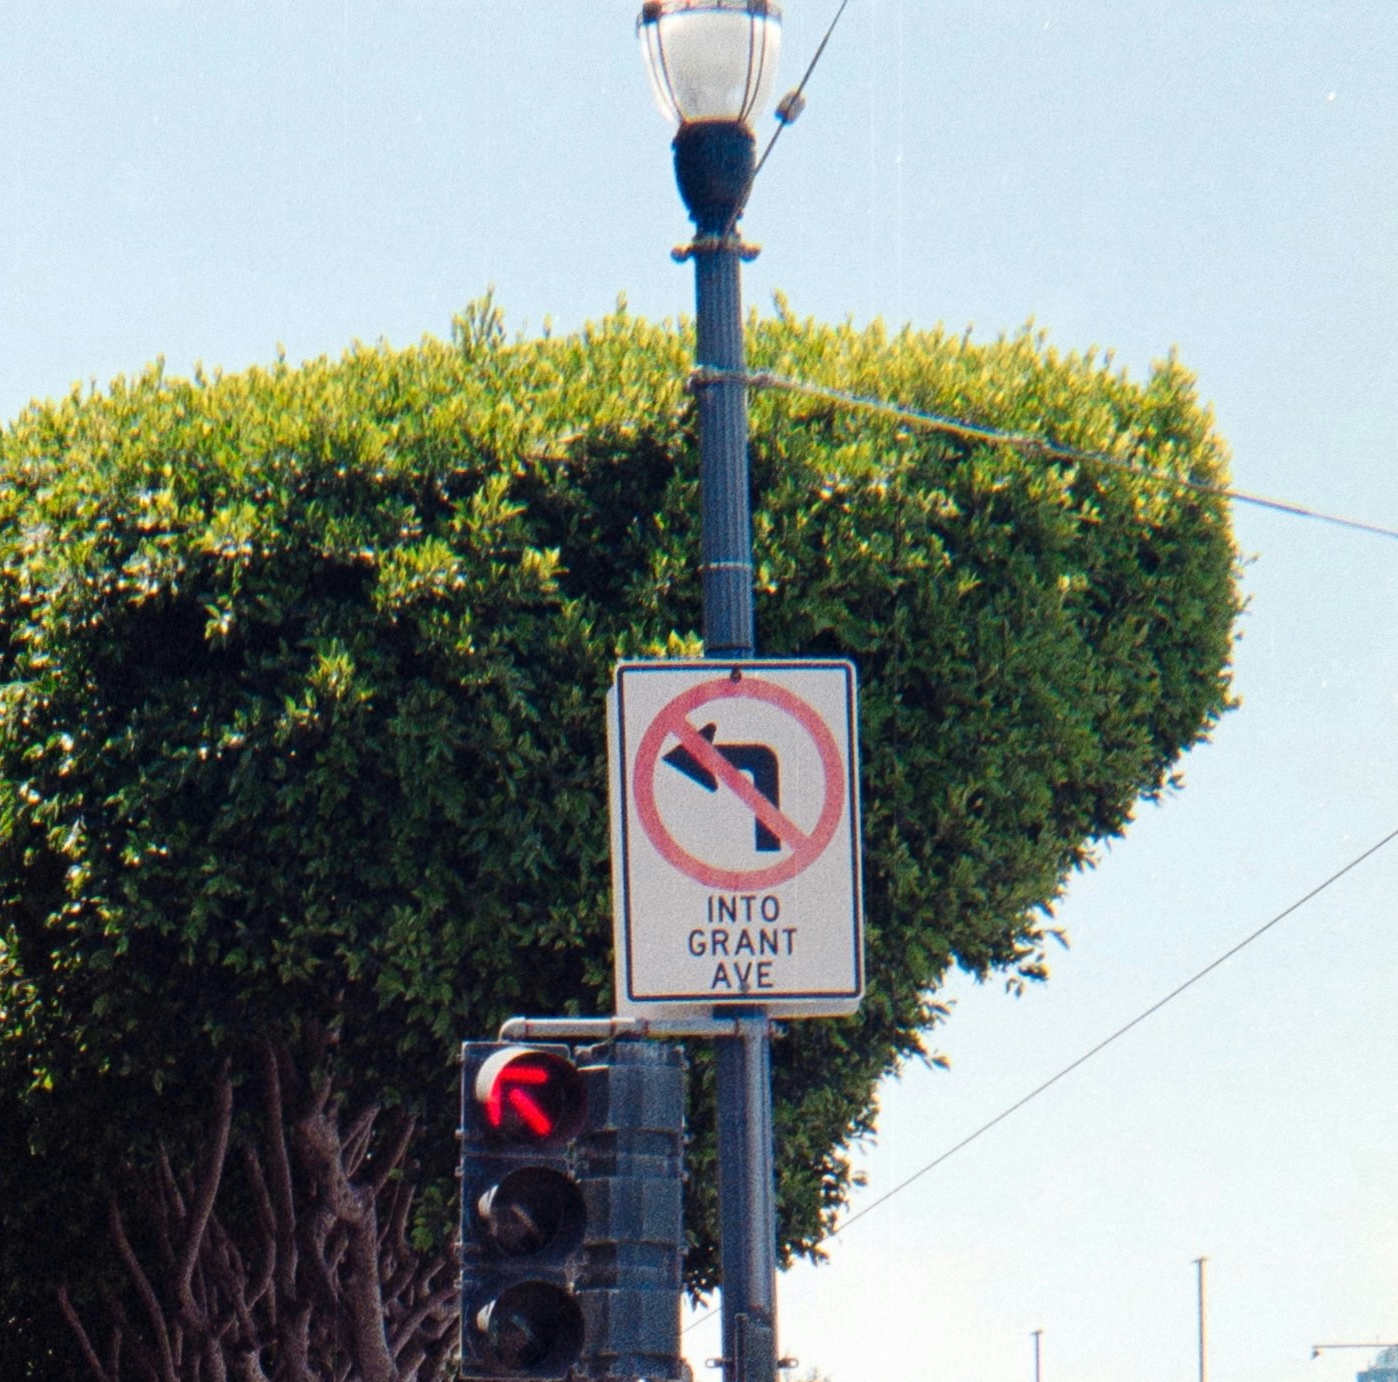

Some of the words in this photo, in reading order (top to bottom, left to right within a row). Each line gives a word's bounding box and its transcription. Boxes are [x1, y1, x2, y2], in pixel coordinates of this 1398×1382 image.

[707, 895, 780, 923] INTO
[688, 928, 798, 957] GRANT
[710, 962, 774, 990] AVE
